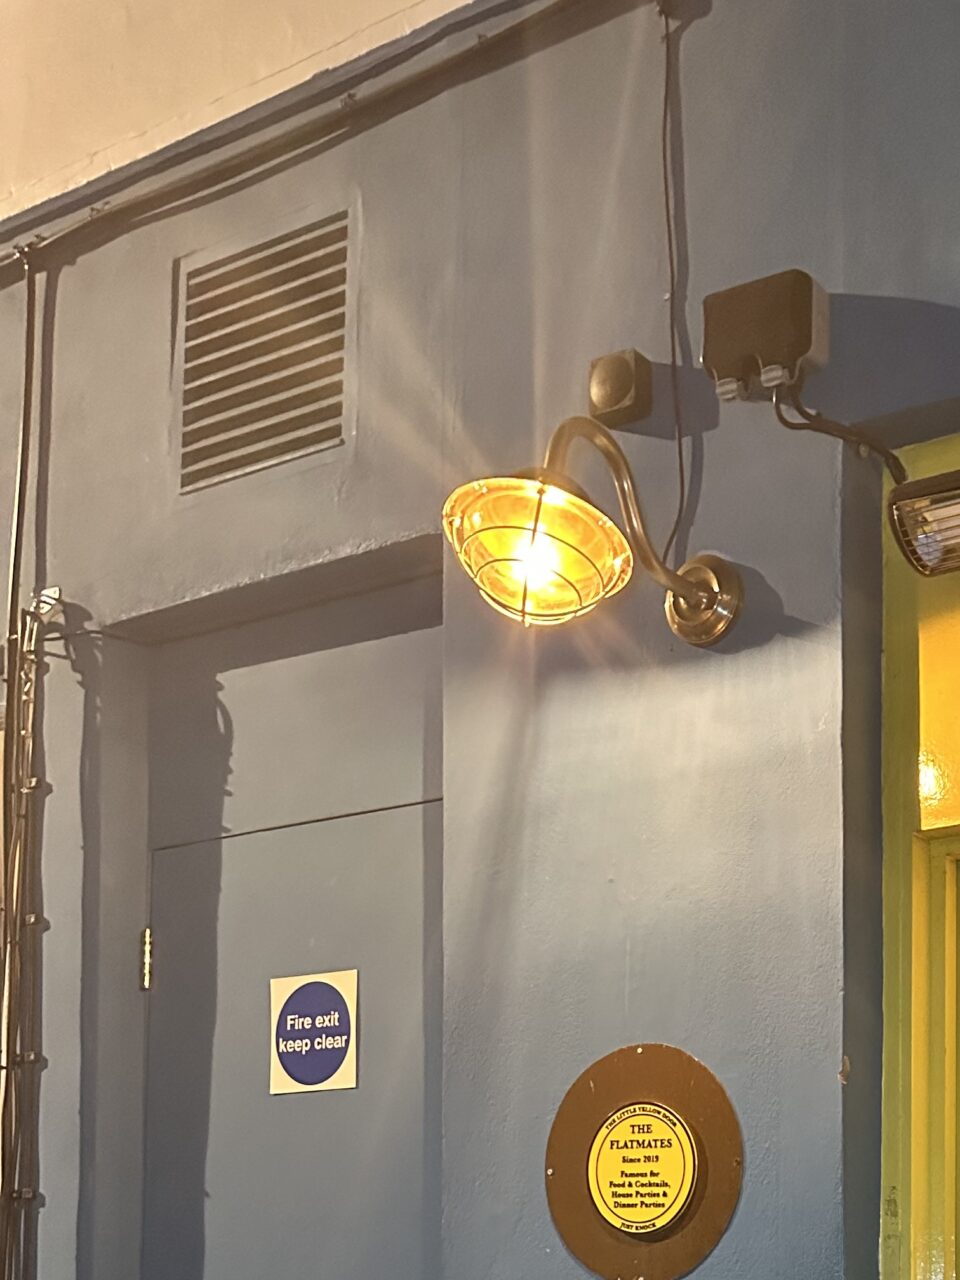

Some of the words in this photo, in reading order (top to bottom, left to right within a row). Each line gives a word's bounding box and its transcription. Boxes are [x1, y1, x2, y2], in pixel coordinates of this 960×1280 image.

[286, 1014, 312, 1031] Fire
[315, 1010, 340, 1028] exit
[278, 1037, 311, 1055] keep
[314, 1033, 348, 1050] clear
[605, 1117, 616, 1130] THE
[616, 1107, 637, 1120] LITTLE
[638, 1106, 661, 1116] YELLOW
[662, 1113, 677, 1127] DOOR
[630, 1124, 653, 1134] THE
[610, 1138, 673, 1150] FLATMATES
[622, 1155, 641, 1163] Since
[620, 1170, 648, 1178] Famous
[609, 1180, 626, 1188] Food
[635, 1180, 671, 1189] Cocktails,
[635, 1190, 660, 1198] Parties
[662, 1190, 668, 1198] &
[614, 1201, 638, 1209] Dinner
[640, 1200, 665, 1208] Parties
[620, 1222, 634, 1230] JUST
[635, 1222, 657, 1231] KNOCK
